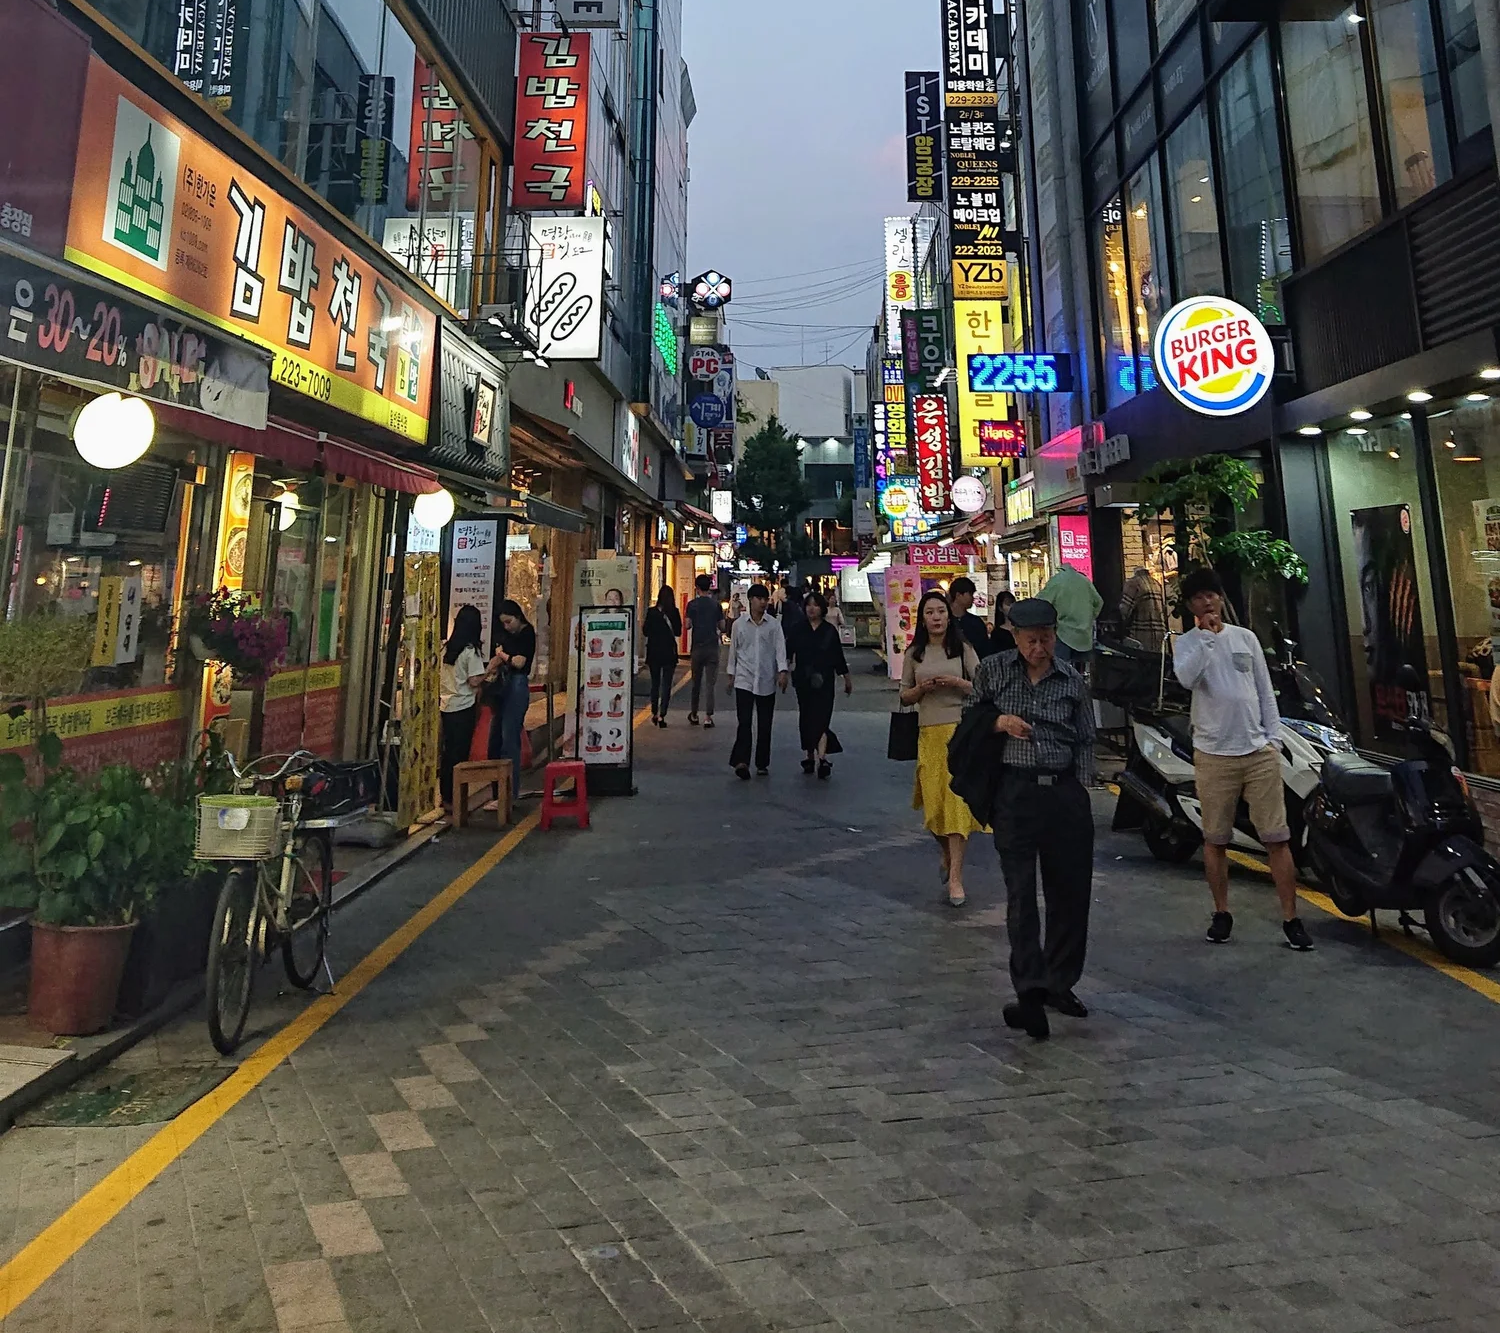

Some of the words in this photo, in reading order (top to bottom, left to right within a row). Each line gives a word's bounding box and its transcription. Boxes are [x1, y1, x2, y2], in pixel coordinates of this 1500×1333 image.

[947, 0, 961, 76] ACADEMY
[947, 80, 984, 91] 미용학원
[916, 76, 930, 134] IST
[949, 96, 995, 105] 229-2323
[523, 35, 581, 203] 김밥천국
[949, 122, 996, 135] 노블퀸즈
[950, 137, 996, 151] 토탈웨딩
[915, 135, 935, 197] 양궁장
[957, 161, 998, 170] QUEENS
[951, 176, 999, 186] 229-2255
[953, 208, 1001, 222] 메이크업
[955, 246, 1003, 255] 222-2023
[228, 177, 391, 396] 김밥천국
[1170, 319, 1251, 360] BURGER
[692, 358, 719, 375] PC
[1177, 338, 1258, 389] KING
[970, 354, 1056, 393] 2255
[984, 428, 1014, 441] Hans
[917, 398, 950, 510] 은성김밥
[912, 548, 962, 563] 은성김밥
